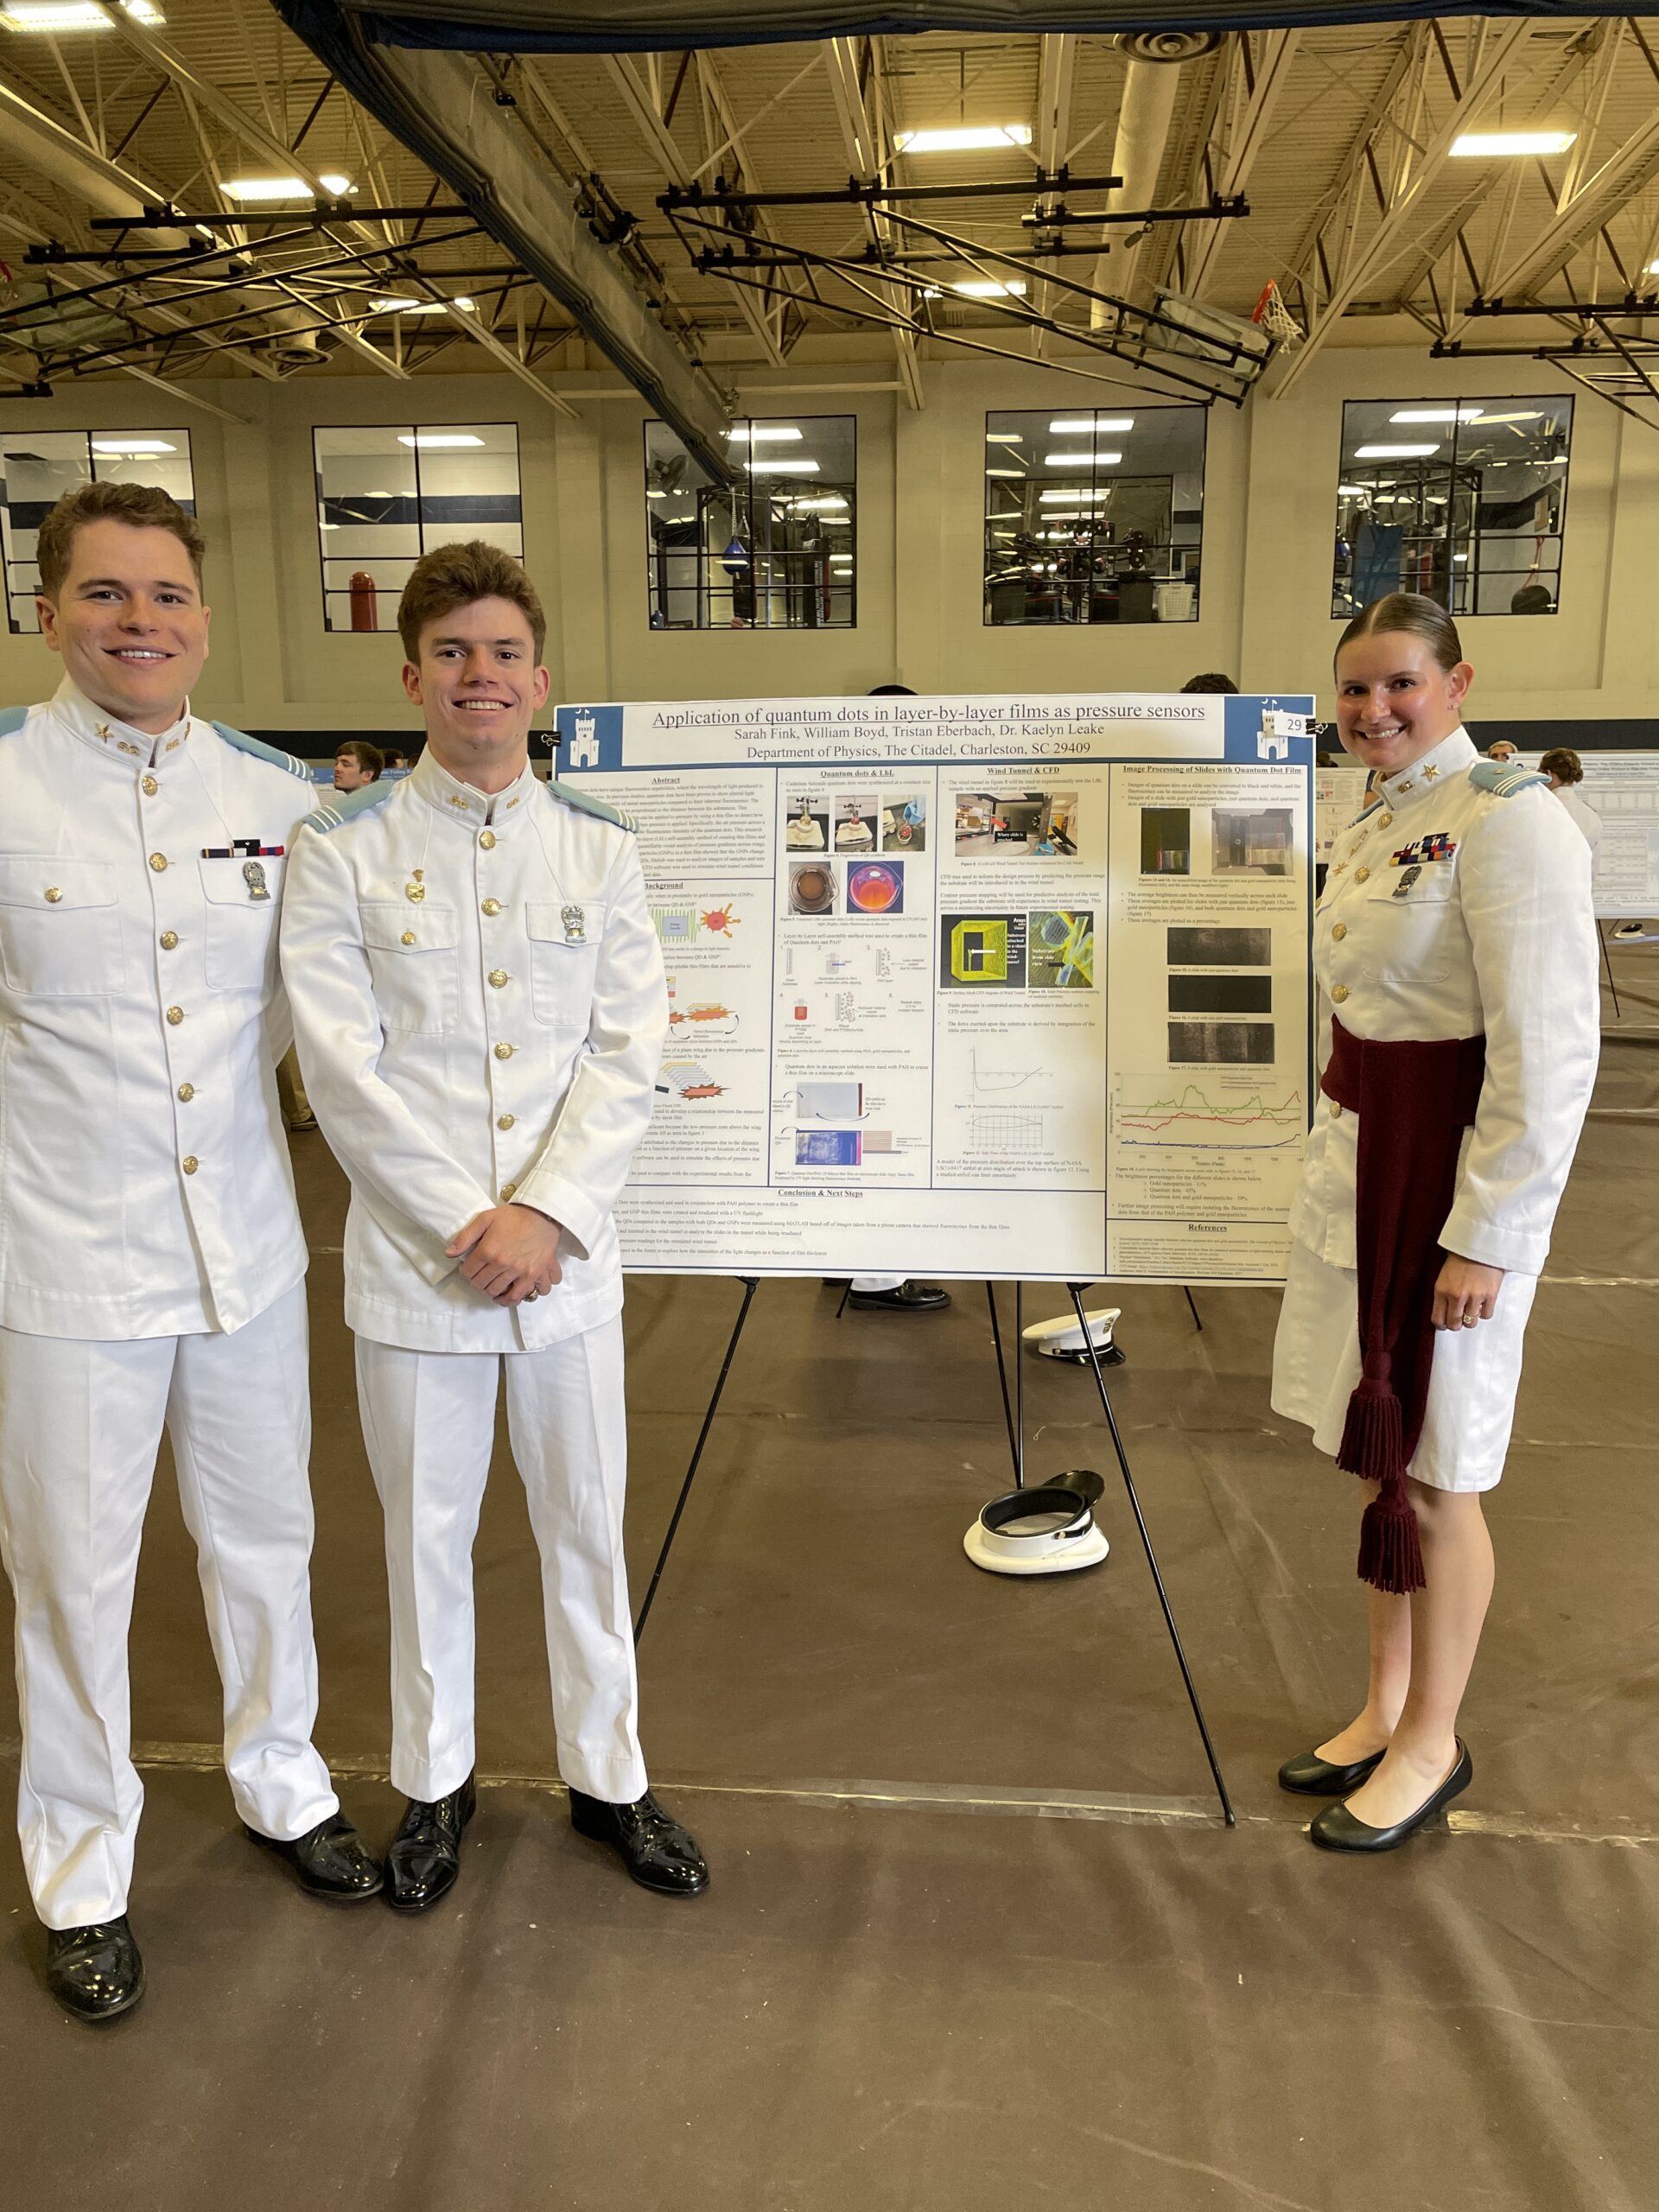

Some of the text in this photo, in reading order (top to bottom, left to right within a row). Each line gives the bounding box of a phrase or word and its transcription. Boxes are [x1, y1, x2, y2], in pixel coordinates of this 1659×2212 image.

[653, 704, 1205, 728] Application of quantum dots in layer-by-layer films as pressure sensors
[1287, 719, 1301, 730] 29
[734, 723, 1104, 740] Sarah Fink, William Boyd, Tristan Eberbach, Dr. Kaelyn Leake
[747, 742, 1090, 760] Department of Physics, The Citadel, Charleston, SC 29409
[1123, 766, 1145, 774] Image
[1146, 766, 1184, 774] Processing
